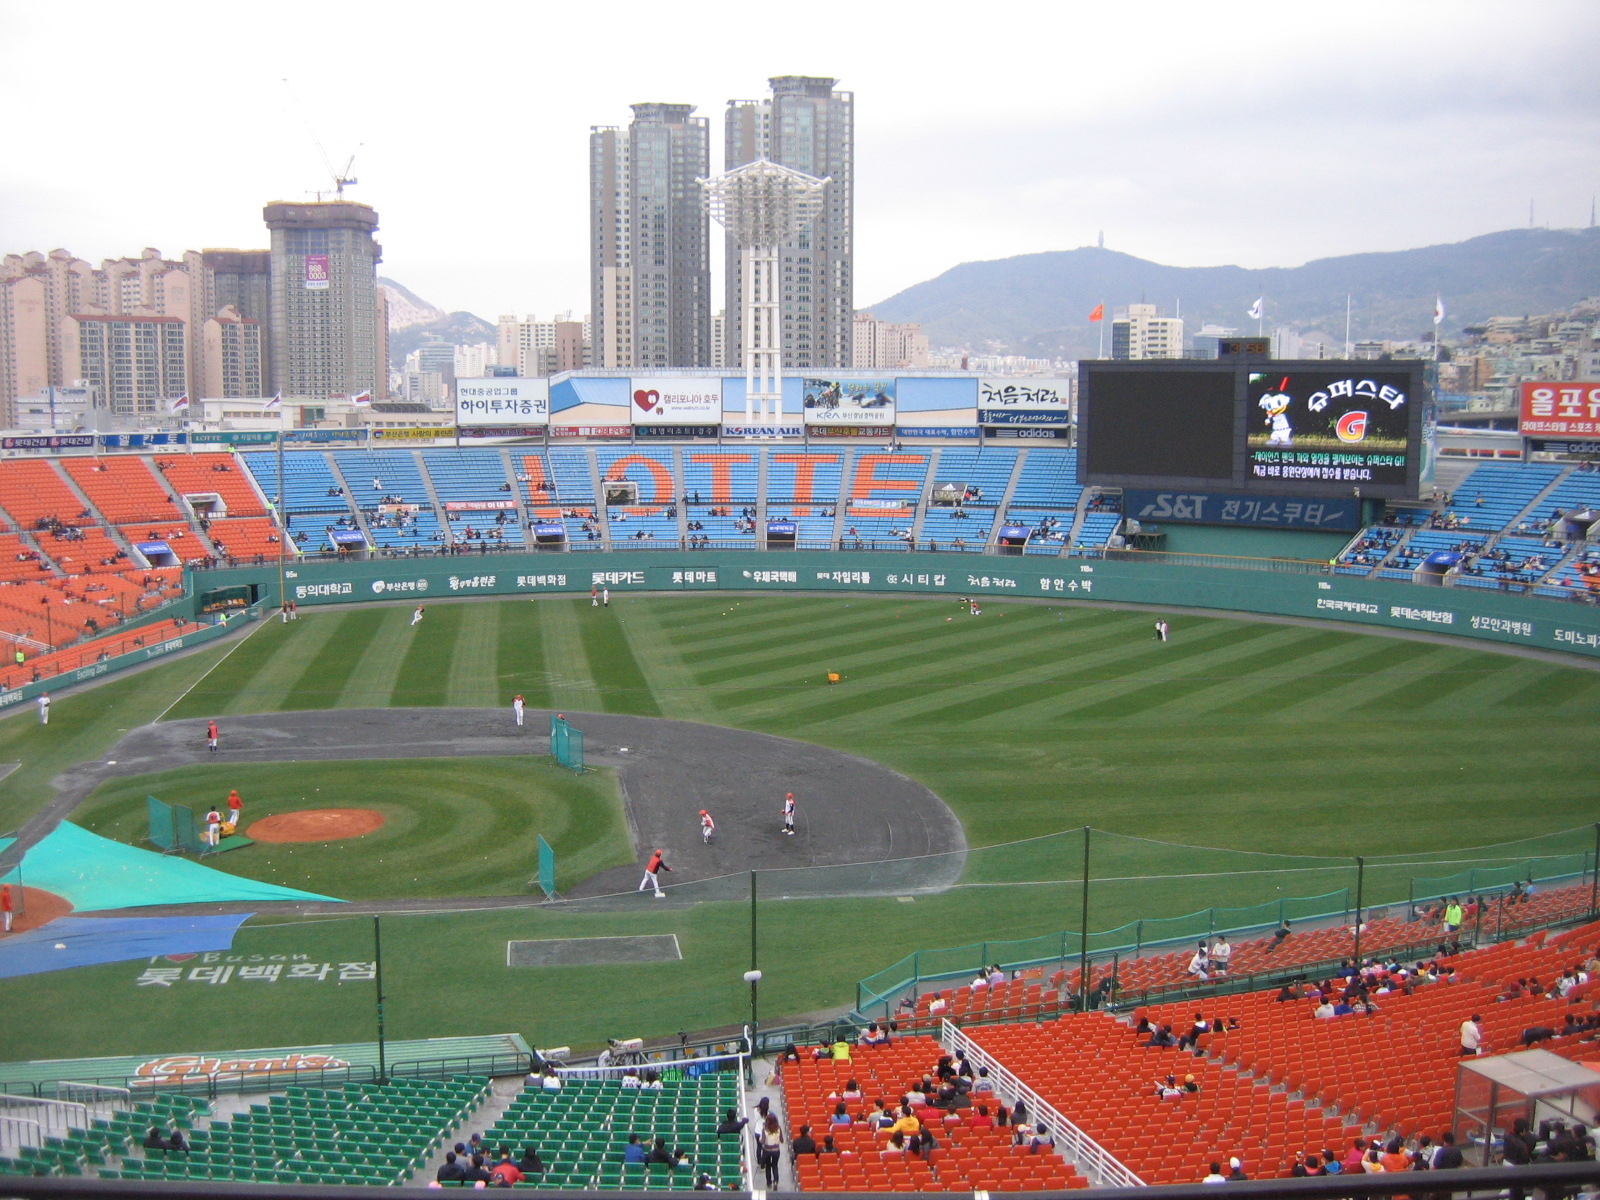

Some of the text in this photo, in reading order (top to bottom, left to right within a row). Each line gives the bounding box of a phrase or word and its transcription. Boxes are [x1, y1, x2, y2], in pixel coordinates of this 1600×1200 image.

[460, 387, 518, 396] 현대중공업그룹
[981, 382, 1058, 405] 처음처럼
[1308, 378, 1406, 413] 슈퍼스타
[663, 394, 719, 404] 캘리포니아 호두
[460, 399, 547, 415] 하이투자증권
[816, 411, 840, 420] KRA
[726, 427, 801, 436] KOREAN AIR
[1019, 428, 1055, 438] adidas
[1336, 411, 1367, 443] G
[1569, 422, 1592, 432] 스포츠
[411, 430, 432, 438] 사랑의
[14, 437, 92, 447] 롯데건설 롯데건설
[1366, 455, 1393, 467] 슈퍼스타
[1139, 494, 1325, 525] S&T 전기스쿠터
[516, 575, 567, 587] 롯데백화점
[592, 571, 645, 585] 롯데카드
[672, 571, 717, 583] 롯데마트
[753, 571, 797, 583] 우체국택배
[832, 571, 870, 584] 자일리톨
[901, 574, 946, 586] 시티캅
[967, 574, 1016, 588] 처음처럼
[296, 582, 352, 599] 동의대학교
[386, 581, 415, 592] 부산은행
[1040, 578, 1092, 592] 함안수박
[1316, 598, 1378, 614] 한국국제대학교
[1391, 606, 1453, 624] 롯데손해보험
[1470, 615, 1532, 636] 성모안과병원
[1553, 629, 1600, 648] 도미노피
[77, 664, 107, 680] Exciting Zone
[202, 952, 310, 963] Busan
[136, 961, 377, 987] 롯데백화점
[129, 1054, 351, 1088] Giants
